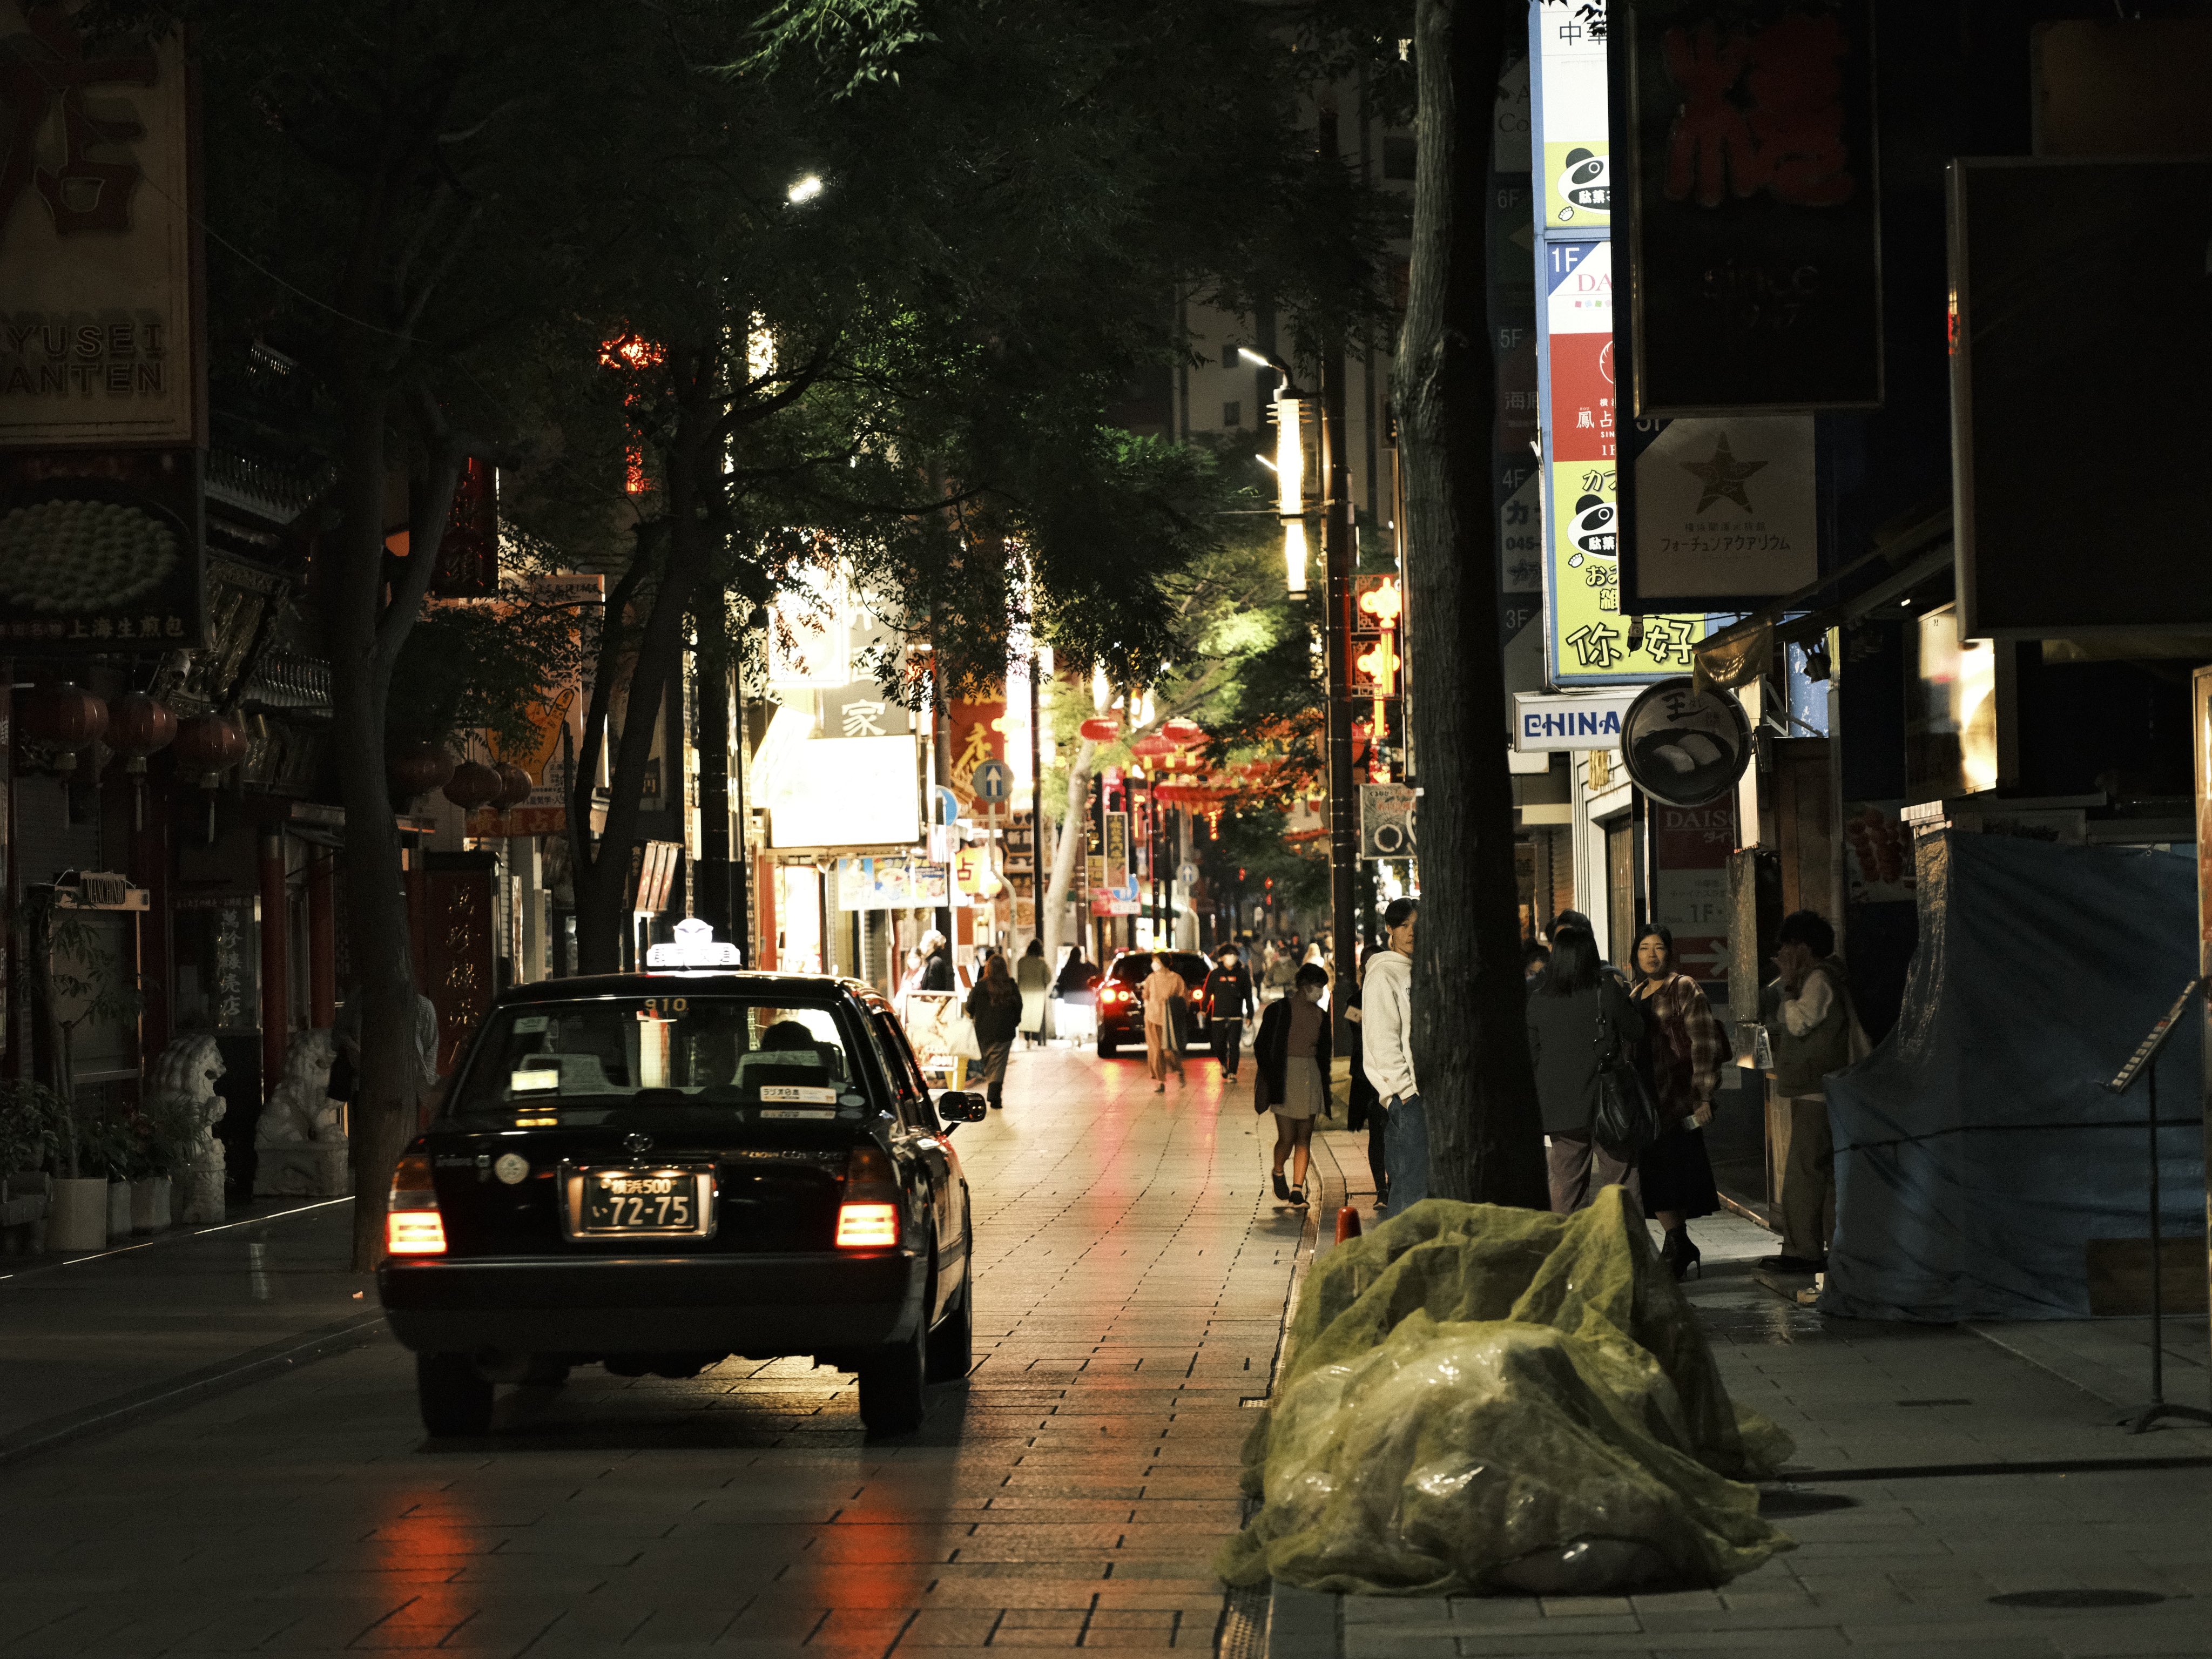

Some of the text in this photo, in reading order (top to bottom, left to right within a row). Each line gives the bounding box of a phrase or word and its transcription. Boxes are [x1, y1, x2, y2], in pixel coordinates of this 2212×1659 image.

[1498, 189, 1519, 209] 6F
[1552, 247, 1580, 273] 1F
[1500, 329, 1522, 349] 5F
[1502, 469, 1526, 488] 4F
[1660, 534, 1791, 552] フォーチュンアクアリウム
[1506, 609, 1529, 629] 3F
[1566, 622, 1698, 667] 你好
[1524, 711, 1621, 738] CHINA
[644, 997, 687, 1012] 910
[609, 1196, 690, 1225] 72-75
